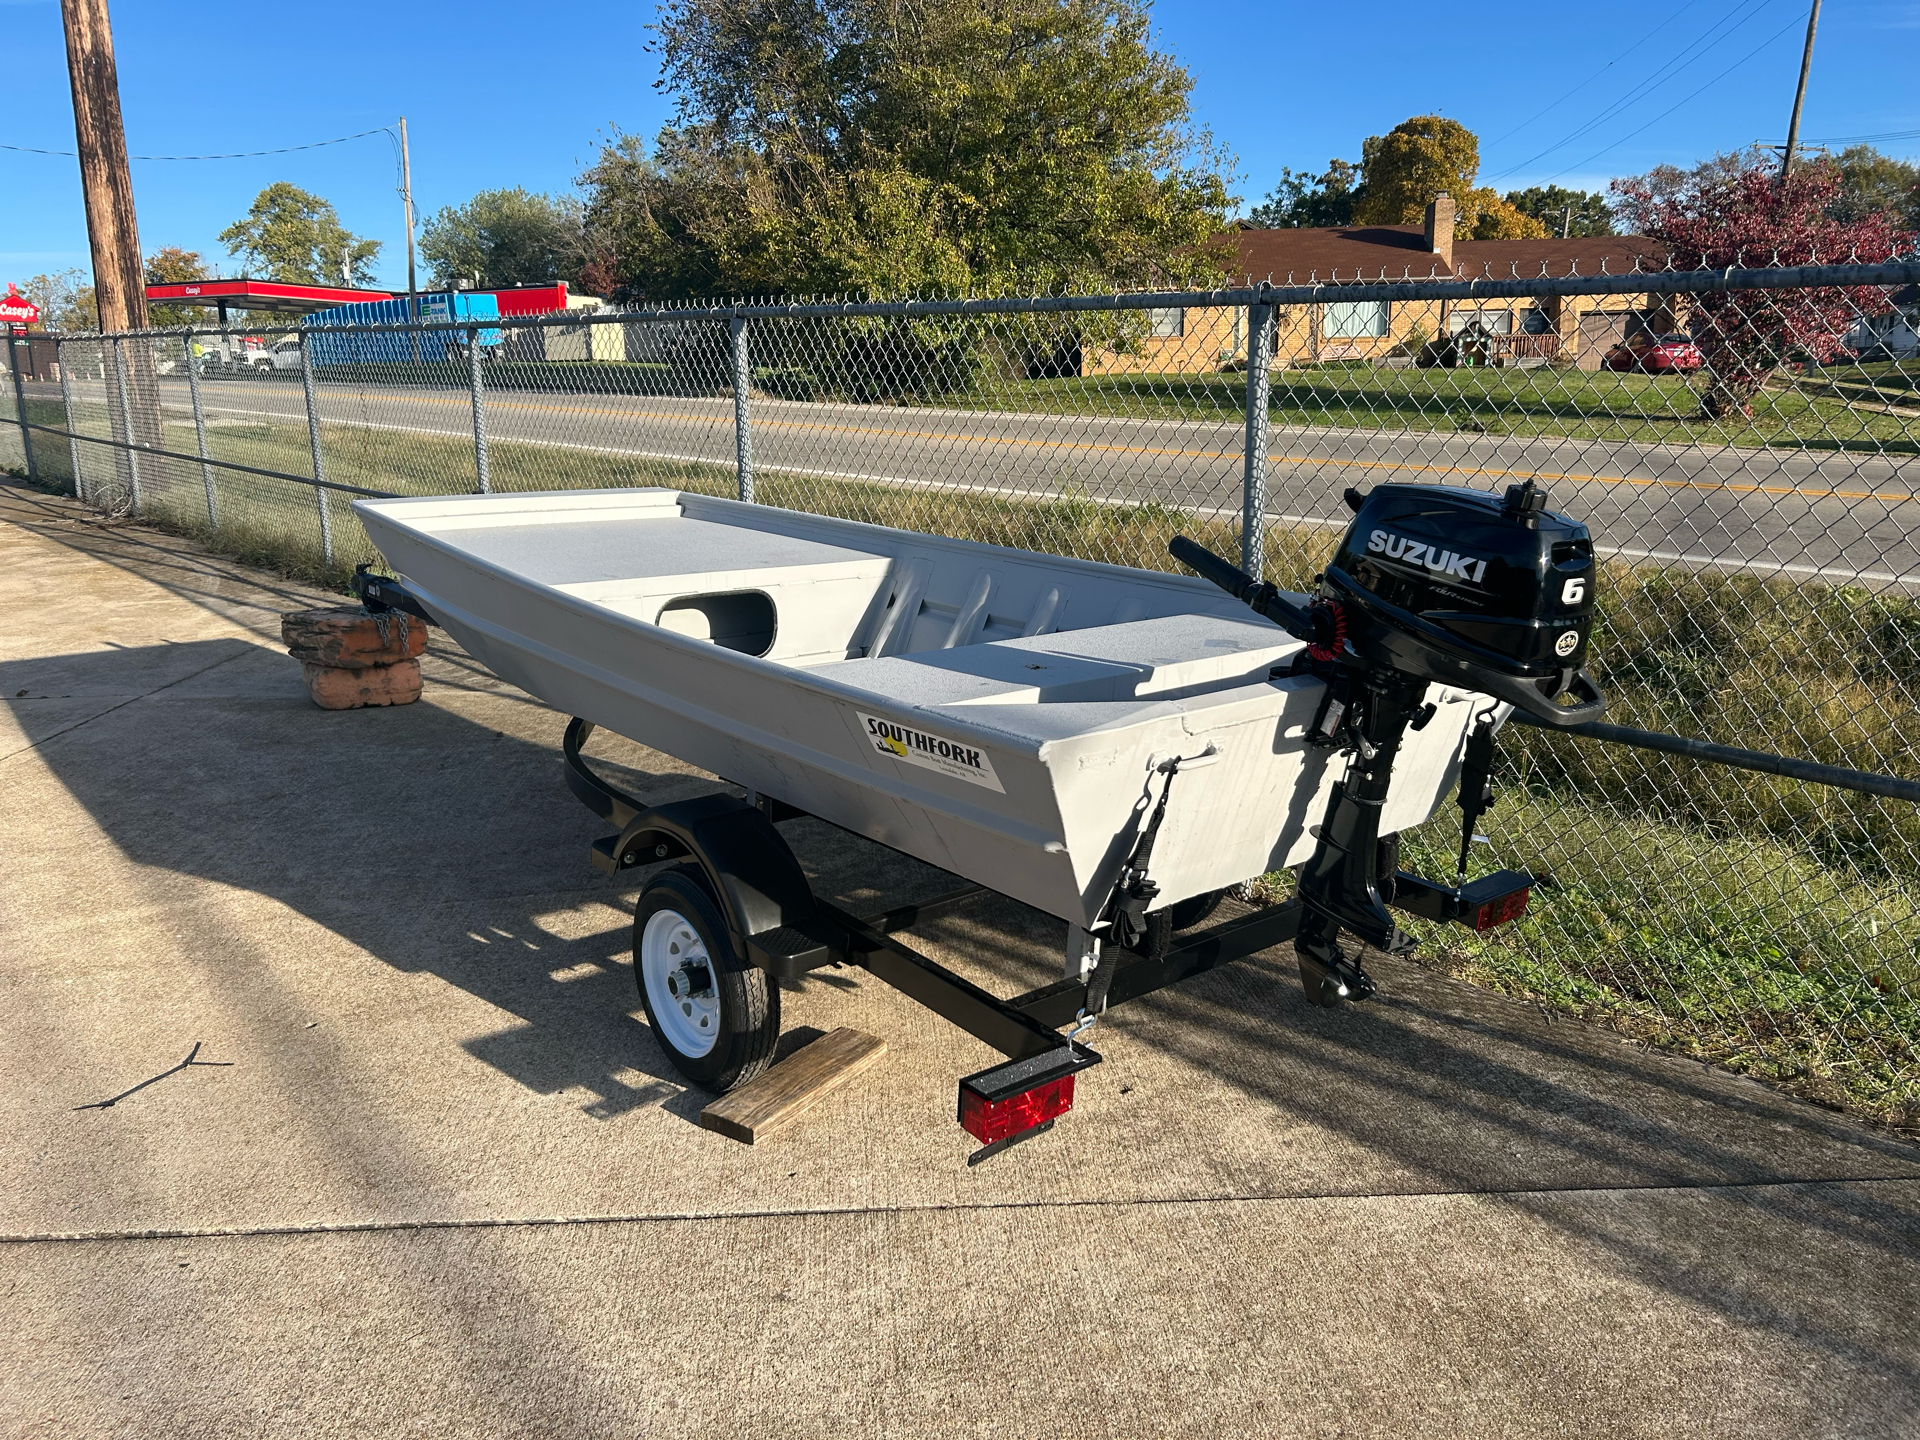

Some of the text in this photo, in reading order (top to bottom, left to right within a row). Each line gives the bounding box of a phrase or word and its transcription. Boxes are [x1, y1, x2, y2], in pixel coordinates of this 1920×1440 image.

[0, 303, 35, 319] Casey's
[1367, 529, 1487, 583] SUZUKI
[1561, 577, 1586, 605] 6
[867, 718, 981, 769] SOUTHFORK
